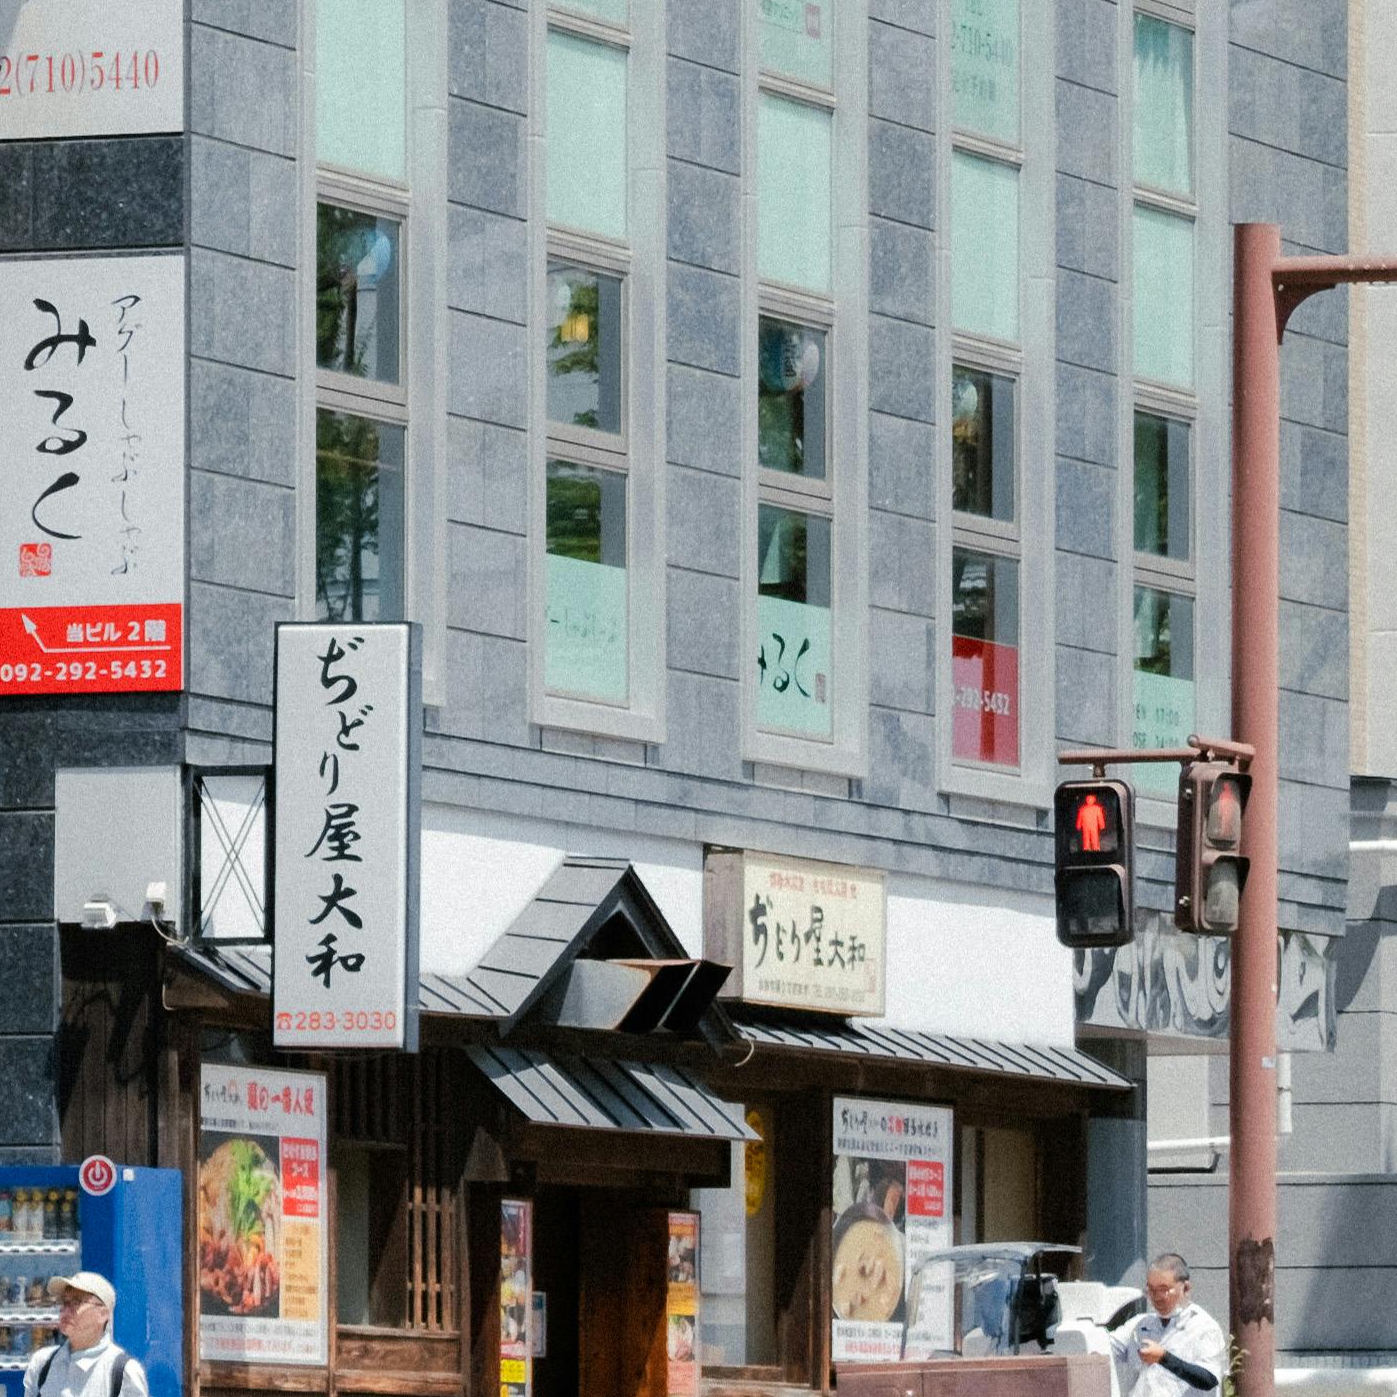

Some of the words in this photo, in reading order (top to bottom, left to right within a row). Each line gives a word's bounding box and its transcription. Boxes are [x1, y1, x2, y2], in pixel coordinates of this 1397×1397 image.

[24, 298, 97, 540] みるく
[0, 659, 168, 682] 092-292-5432
[304, 636, 374, 990] ぢどり屋大和
[295, 1011, 397, 1031] 283-3030
